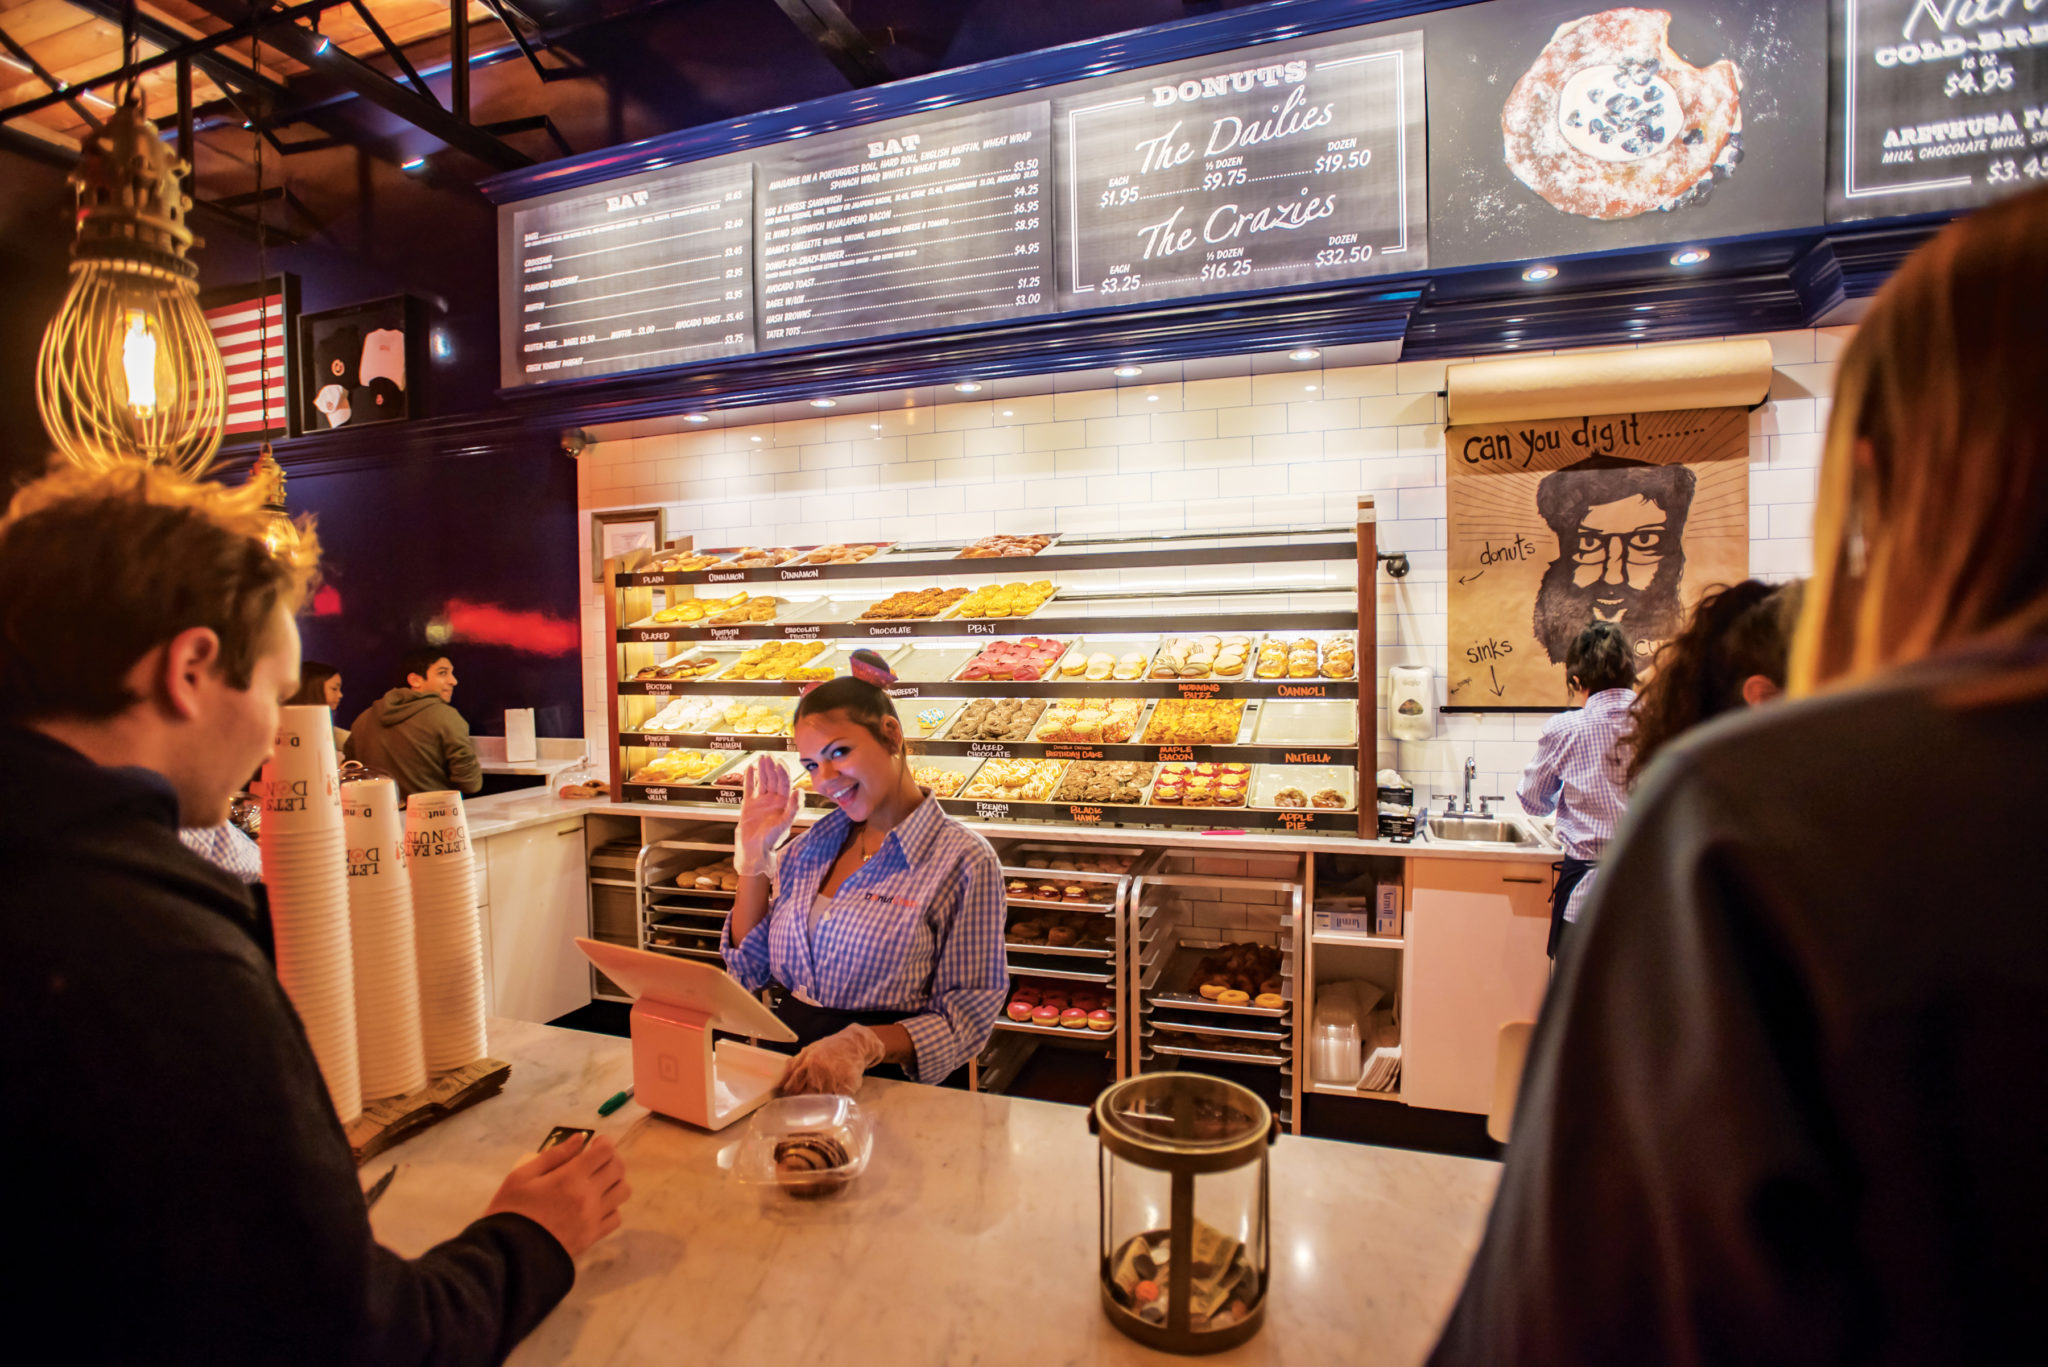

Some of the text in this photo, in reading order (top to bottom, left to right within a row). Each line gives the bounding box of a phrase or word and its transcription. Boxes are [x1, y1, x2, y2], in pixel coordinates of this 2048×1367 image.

[1962, 56, 1975, 70] 16
[1152, 60, 1307, 107] DONUTS
[1944, 62, 2015, 98] $4.95
[1135, 84, 1334, 175] The Dailies
[1883, 111, 2018, 148] ARETHUSA
[867, 134, 920, 158] EAT
[1882, 133, 2025, 164] MILK, CHOCOLATE MILK,
[769, 131, 1032, 191] AVAILABLE ON A PORTUGUESE ROLL, HARD ROLL, ENGLISH MUFFIN, WHEAT WRAP
[1108, 176, 1130, 188] EACH
[1215, 156, 1243, 168] DOZEN
[1327, 138, 1357, 152] DOZEN
[830, 177, 859, 191] SPINACH
[882, 168, 904, 180] WHITE
[913, 162, 937, 175] WHEAT
[938, 157, 960, 170] BREAD
[1100, 150, 1372, 207] $1.95 $9.75 $19.50
[764, 207, 776, 217] EGG
[784, 200, 806, 213] CHEESE
[807, 194, 842, 209] SANDWICH
[1014, 158, 1038, 172] $3.50
[606, 190, 648, 212] EAT
[725, 190, 742, 201] $1.65
[765, 231, 772, 241] EL
[790, 222, 825, 236] SANDWICH
[826, 214, 868, 229] W/JALAPENO
[869, 210, 892, 222] BACON
[1014, 184, 1039, 198] $4.25
[791, 238, 822, 251] OMELETTE
[1014, 200, 1039, 215] $6.95
[1014, 218, 1039, 232] $8.95
[1137, 187, 1336, 261] The Crazies
[1109, 263, 1130, 275] EACH
[1215, 248, 1244, 259] DOZEN
[1328, 234, 1358, 246] DOZEN
[765, 242, 1040, 294] AVOCADO TOAST $4.95
[1100, 246, 1372, 295] $3.25 $16.25 $32.50
[766, 276, 1040, 325] HASH BROWNS $1.25
[766, 298, 784, 309] BAGEL
[675, 318, 702, 330] AVOCADO
[703, 315, 721, 325] TOAST
[766, 293, 1040, 339] TATER TOTS $3.00
[724, 333, 744, 345] $3.75
[1520, 427, 1560, 468] you
[1571, 416, 1614, 452] dig
[1480, 533, 1536, 566] donuts
[642, 575, 664, 584] PLAIN
[708, 572, 745, 583] CINNAMON
[781, 569, 819, 580] CINNAMON
[785, 626, 820, 634] CHOCOLATE
[869, 626, 912, 636] CHOCOLATE
[968, 623, 997, 634] PB&J
[1466, 638, 1513, 664] sinks
[1178, 683, 1220, 693] MORNING
[1184, 691, 1213, 699] BUZZ
[1278, 685, 1326, 697] CANNOLI
[967, 750, 1011, 758] CHOCOLATE
[972, 743, 1004, 752] GLAZED
[1045, 750, 1103, 759] BIRTHDAY CAKE
[1159, 745, 1192, 753] MAPLE
[1159, 752, 1194, 761] BACON
[1285, 753, 1331, 764] NUTELLA
[715, 796, 742, 804] VELVET
[976, 802, 1009, 811] FRENCH
[976, 810, 1008, 818] TOAST
[1070, 805, 1103, 814] BLACK
[1073, 813, 1102, 822] HAWK
[1278, 813, 1314, 823] APPLE
[1286, 821, 1307, 831] PIE
[407, 826, 465, 844] DONUTS
